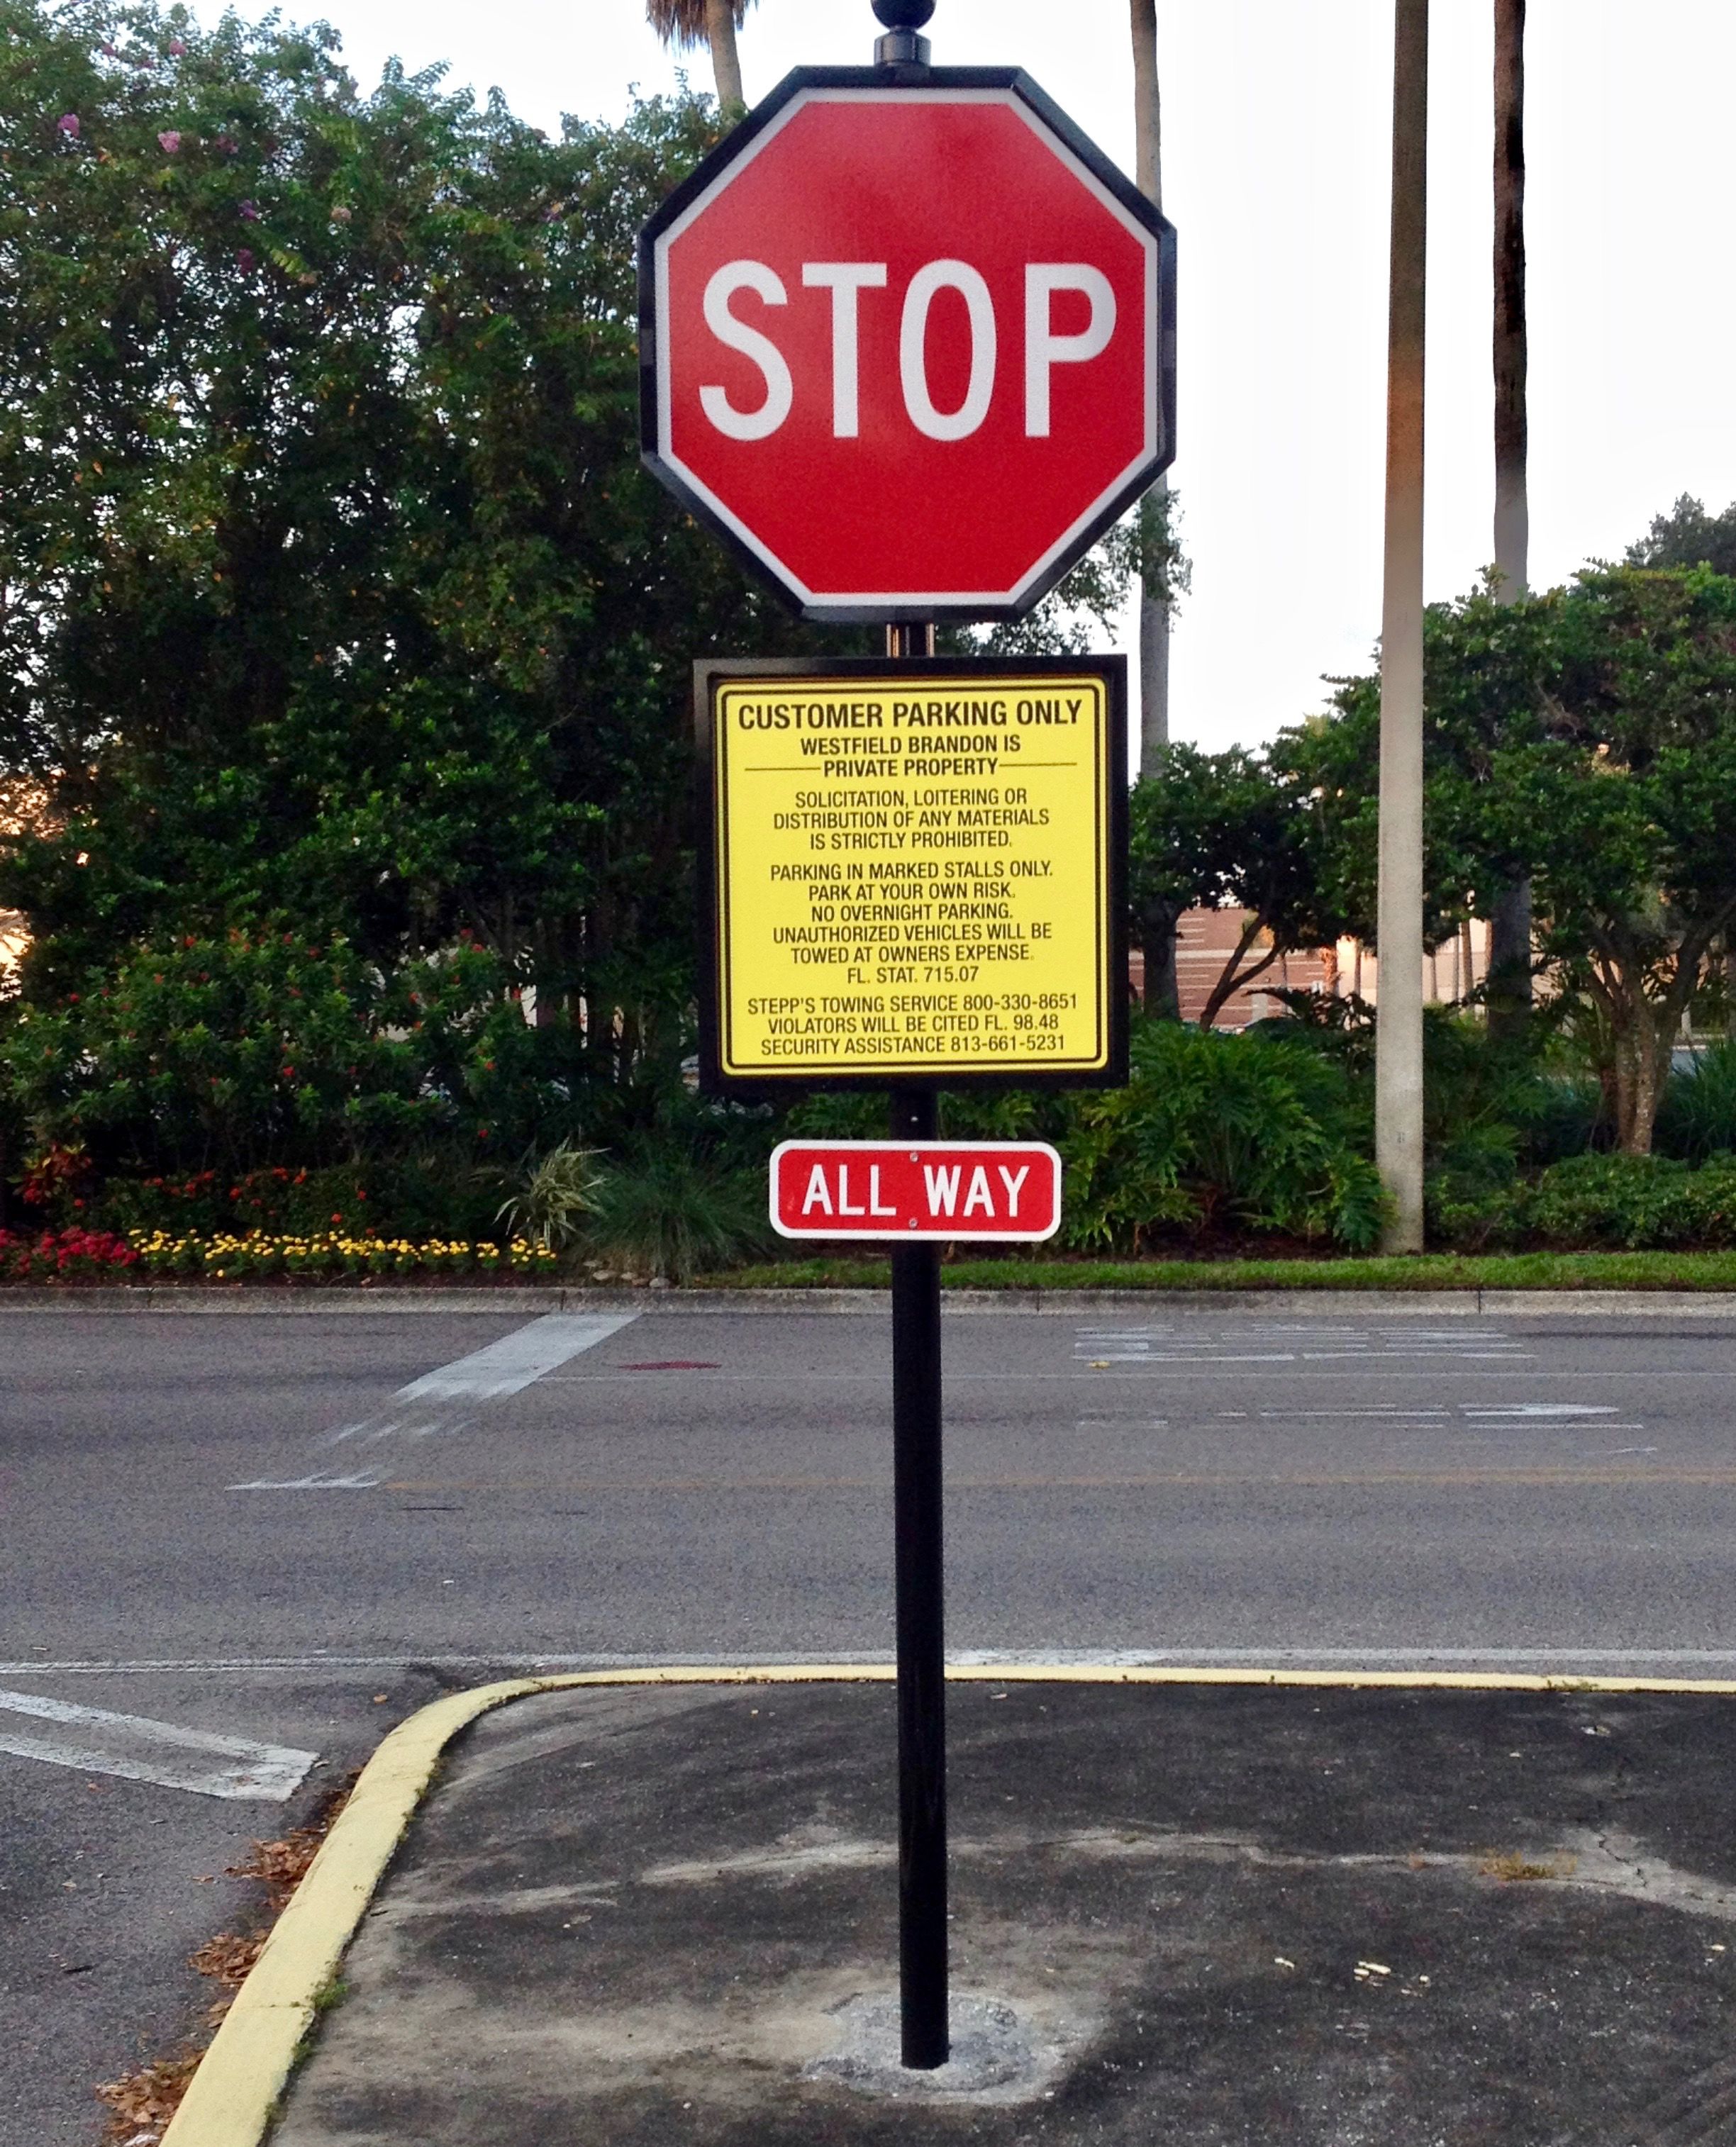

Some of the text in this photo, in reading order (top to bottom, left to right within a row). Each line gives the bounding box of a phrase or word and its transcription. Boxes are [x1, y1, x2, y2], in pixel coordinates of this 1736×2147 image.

[699, 260, 1116, 441] STOP
[739, 700, 1081, 730] CUSTOMER PARKING ONLY
[801, 735, 1020, 755] WESTFIELD BRANDON IS
[824, 758, 998, 777] PRIVATE PROPERTY
[796, 788, 1027, 808] SOLICITATION, LOITERING OR
[774, 809, 1049, 829] DISTRIBUTION OF ANY MATERIALS
[811, 830, 1011, 849] IS STRICTLY PROHIBITED.
[772, 861, 1052, 881] PARKING IN MARKED STALLS ONLY.
[809, 882, 1015, 901] PARK AT YOUR OWN RISK.
[812, 903, 1013, 922] NO OVERNIGHT PARKING.
[774, 922, 1052, 943] UNAUTHORIZED VEHICLES WILL BE
[791, 947, 848, 964] TOWED
[854, 947, 872, 962] AT
[879, 945, 950, 962] OWNERS
[848, 966, 979, 983] FL. STAT. 715.07
[748, 994, 1076, 1014] STEPP'S TOWING SERVICE 800-330-8651
[769, 1015, 1058, 1034] VIOLATORS WILL BE CITED FL. 98.48
[762, 1035, 1063, 1055] SECURITY ASSISTANCE 813-661-5231
[802, 1164, 1029, 1217] ALL WAY
